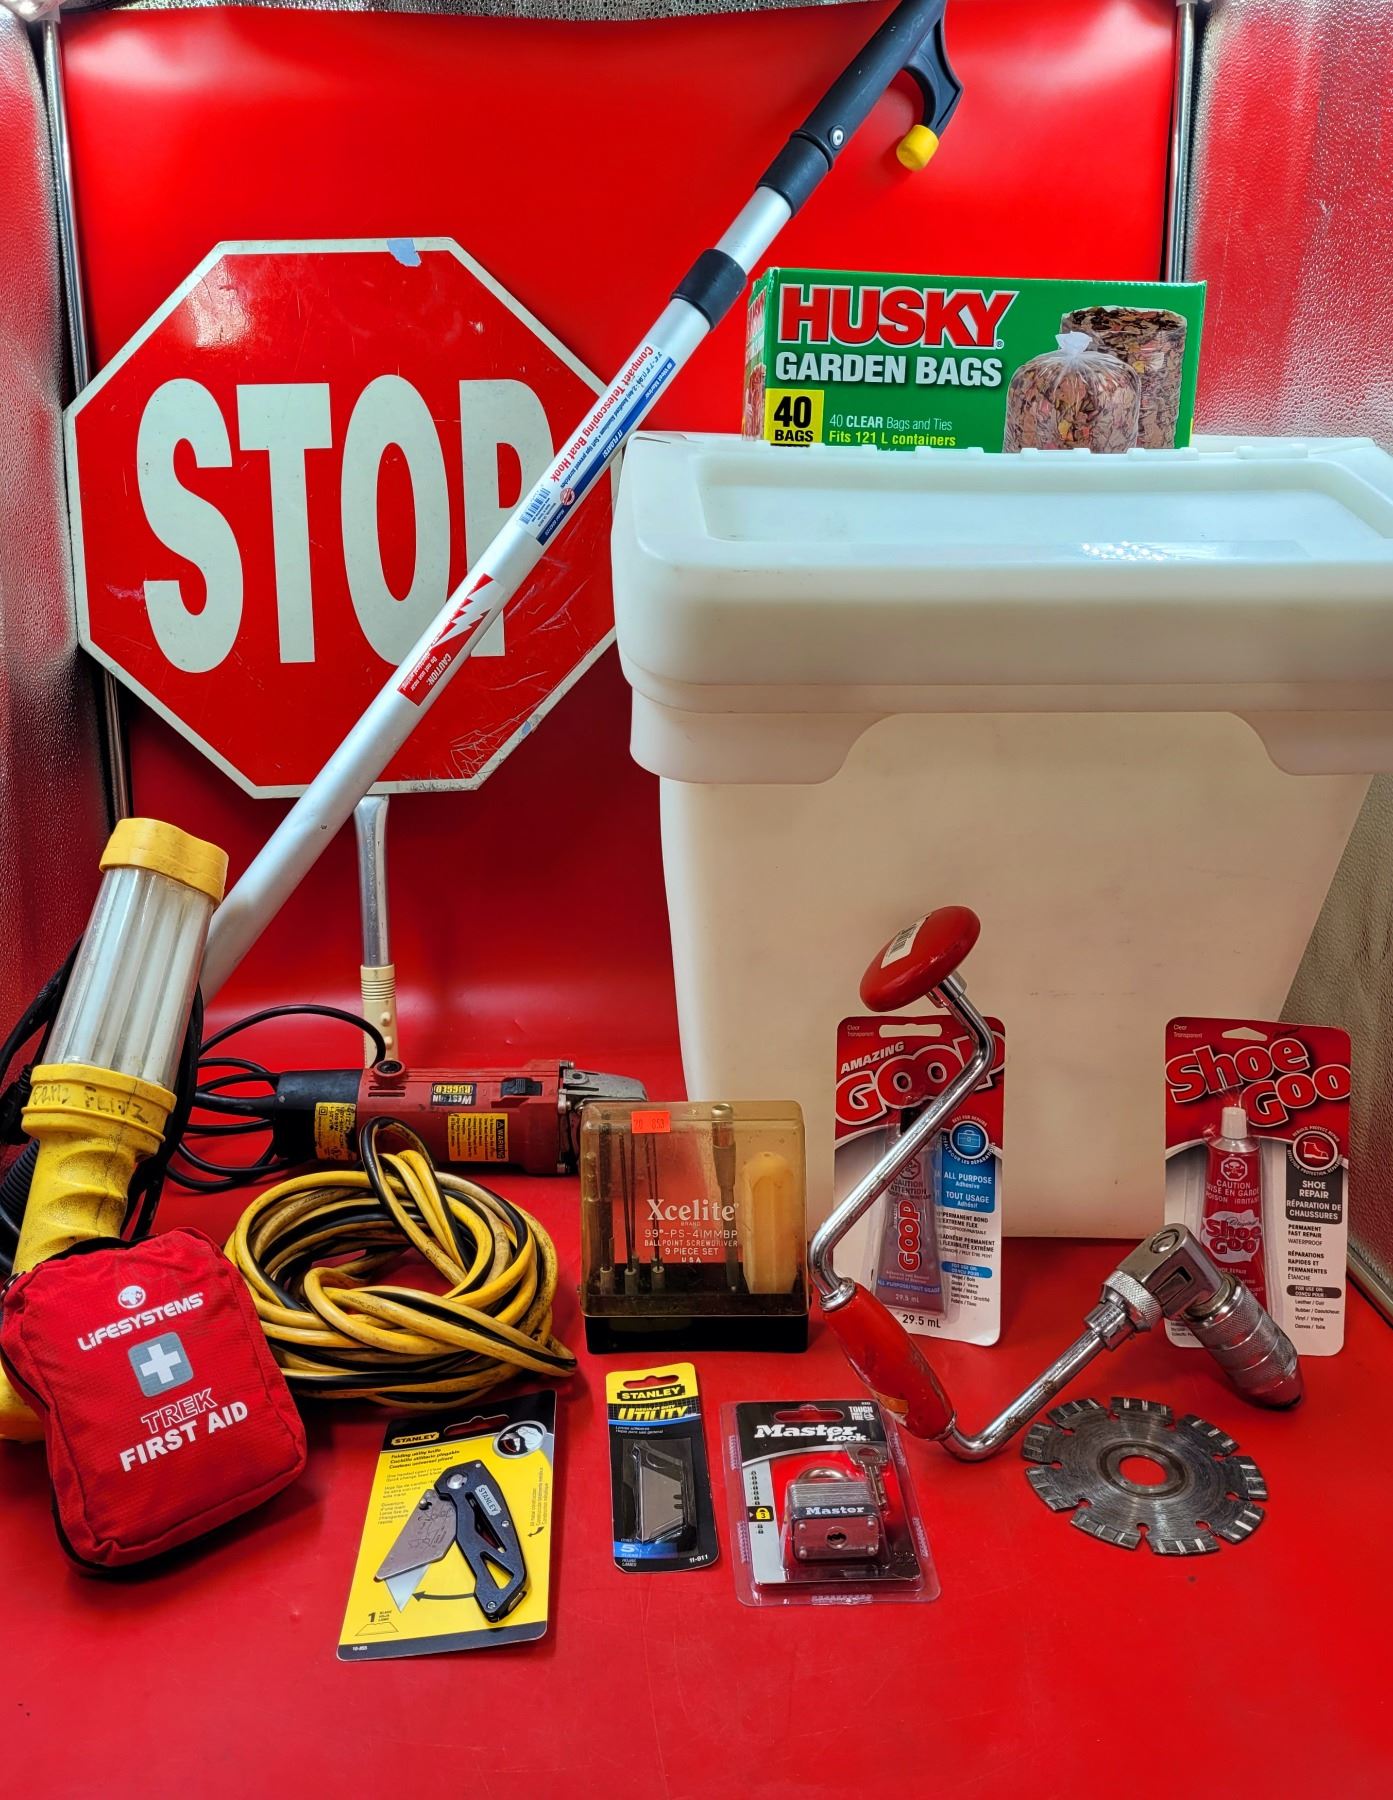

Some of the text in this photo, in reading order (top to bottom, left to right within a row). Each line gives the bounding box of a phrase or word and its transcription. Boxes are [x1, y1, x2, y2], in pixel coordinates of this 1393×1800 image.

[779, 282, 1019, 349] HUSKY
[619, 344, 654, 386] Compact
[775, 351, 1003, 388] GARDEN BAGS
[581, 383, 625, 438] Telescoping
[774, 396, 812, 428] 40
[829, 414, 953, 432] 40 CLEAR Bags and Ties
[774, 430, 814, 443] BAGS
[829, 431, 956, 446] Fits 121 L containers
[565, 435, 587, 460] Boat
[548, 457, 572, 484] Hook
[136, 374, 556, 674] STOP
[424, 651, 453, 687] CAUTION:
[840, 1041, 905, 1075] AMAZING
[1165, 1037, 1311, 1104] Shoe
[1239, 1063, 1351, 1128] Goo
[944, 1171, 993, 1185] ALL PURPOSE
[955, 1180, 980, 1189] Adhesive
[1216, 1179, 1251, 1190] CAUTION
[1302, 1179, 1327, 1190] SHOE
[945, 1190, 990, 1204] TOUT USAGE
[1224, 1188, 1235, 1197] EN
[1299, 1188, 1329, 1199] REPAIR
[646, 1198, 735, 1221] Xcelite
[1286, 1198, 1342, 1212] RÉPARATION DE
[973, 1216, 989, 1224] BOND
[1289, 1209, 1339, 1220] CHAUSSURES
[1206, 1218, 1262, 1240] Shoe
[1288, 1223, 1322, 1232] PERMANENT
[898, 1200, 921, 1273] GOOP
[964, 1237, 995, 1246] PERMANENT
[1288, 1238, 1323, 1246] WATERPROOF
[673, 1247, 699, 1255] PIECE
[702, 1247, 719, 1255] SET
[1209, 1237, 1257, 1255] Goo
[1288, 1250, 1325, 1259] RÉPARATIONS
[1288, 1266, 1328, 1275] PERMANENTES
[1288, 1273, 1311, 1281] ÉTANCHE
[902, 1313, 942, 1329] 29.5 mL
[621, 1386, 681, 1400] STANLEY
[140, 1387, 219, 1435] TREK
[618, 1405, 688, 1421] UTILITY
[119, 1401, 248, 1472] FIRST AID
[754, 1424, 858, 1438] Master
[826, 1433, 867, 1442] Lock
[393, 1433, 437, 1444] STANLEY
[478, 1487, 498, 1513] STANLEY
[805, 1506, 865, 1516] Master
[620, 1544, 636, 1553] 5
[367, 1611, 377, 1623] 1
